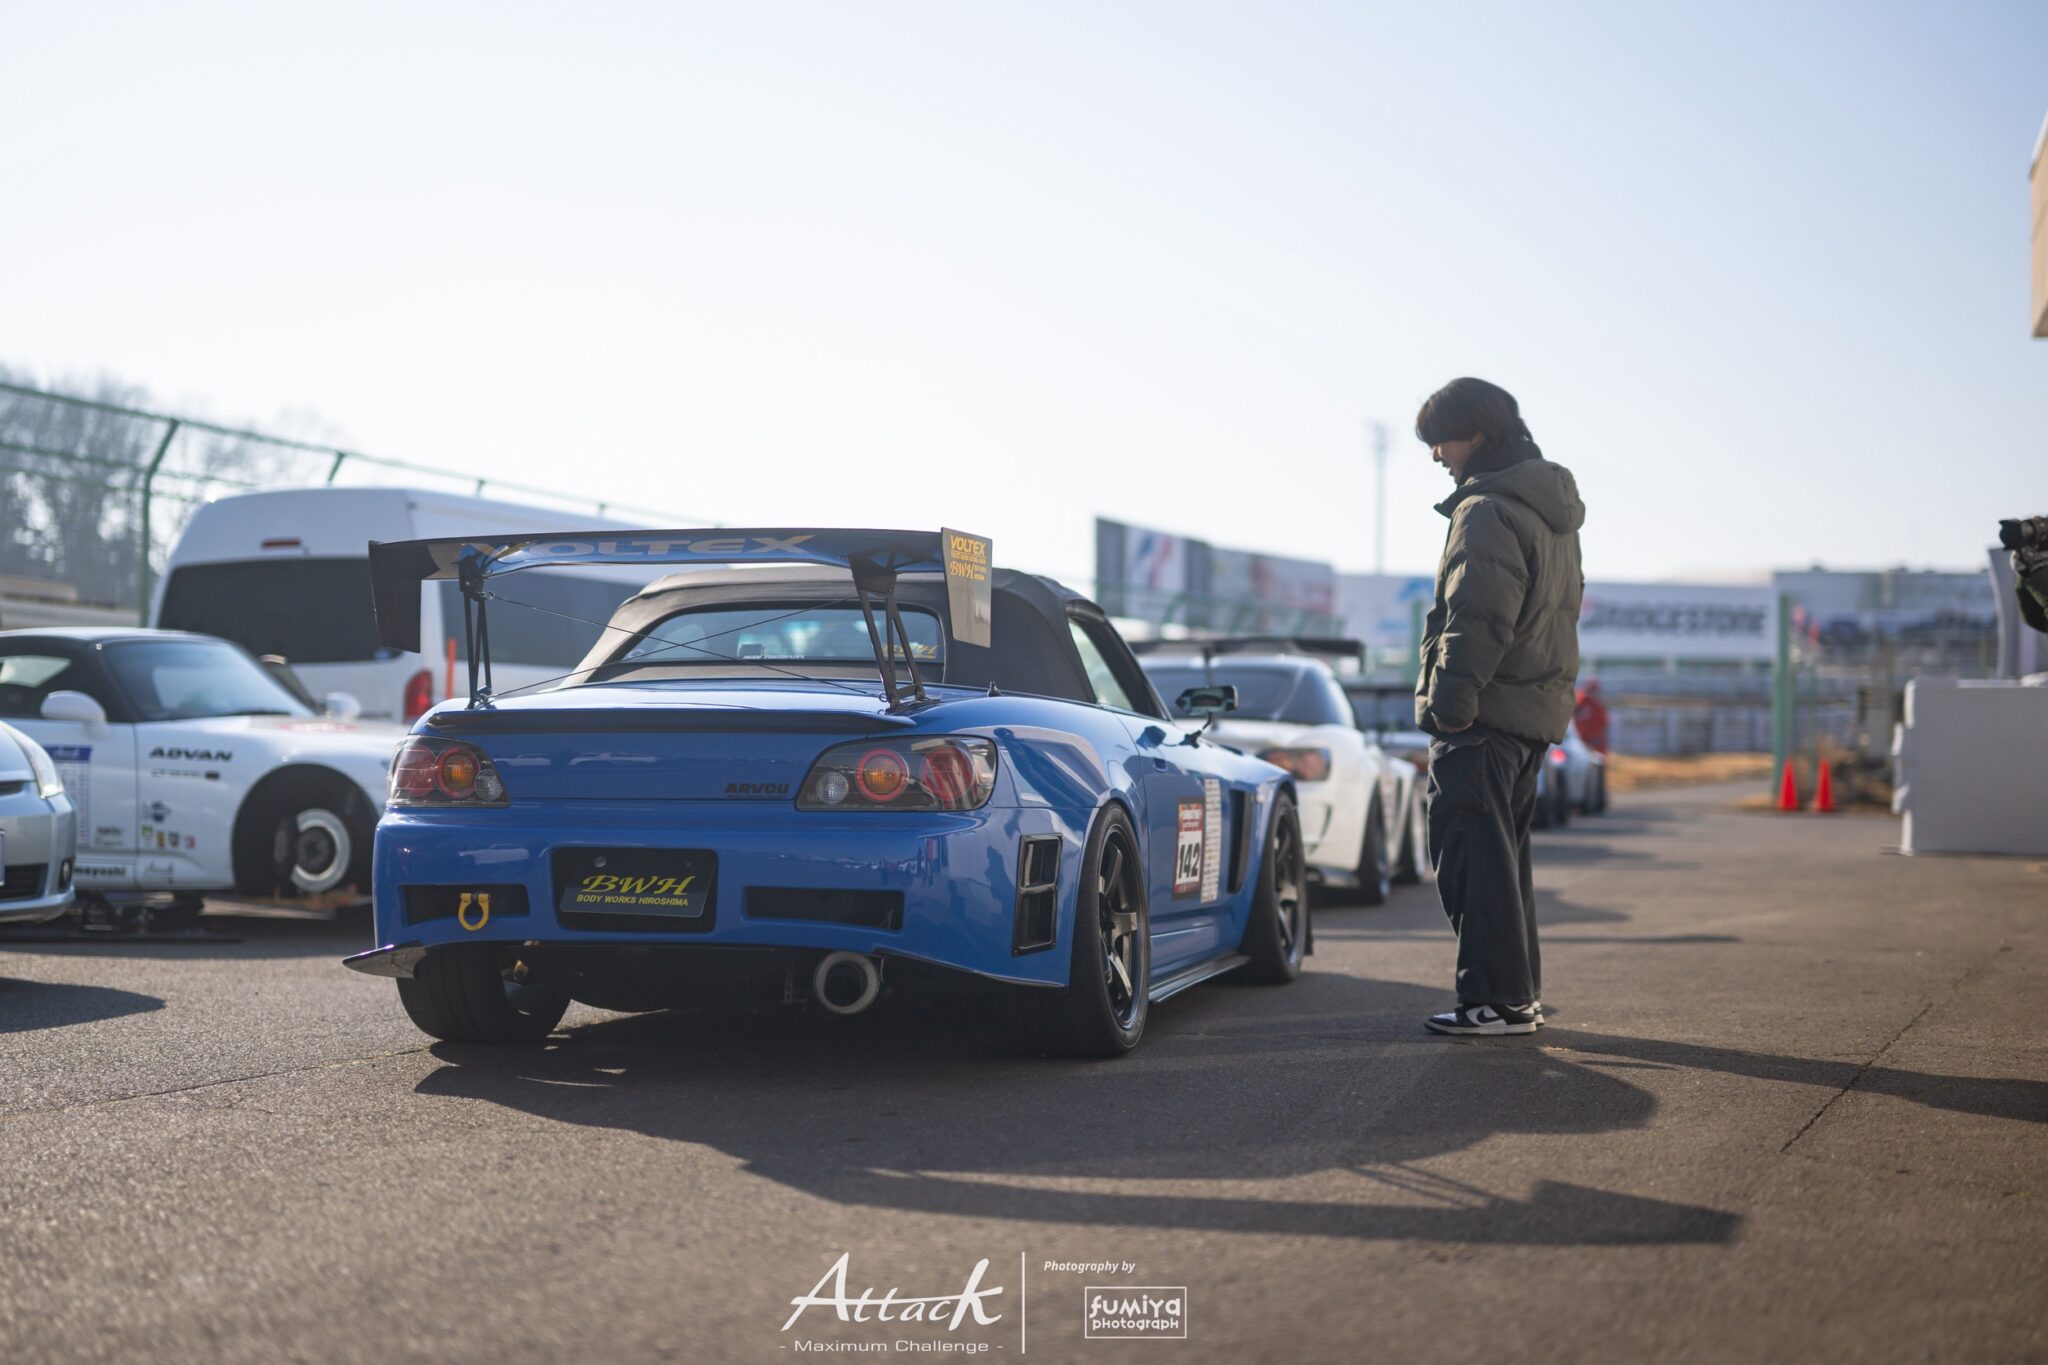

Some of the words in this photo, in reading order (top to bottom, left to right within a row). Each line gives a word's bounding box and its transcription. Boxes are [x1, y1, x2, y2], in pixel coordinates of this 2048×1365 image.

[461, 534, 817, 557] VOLTEX
[950, 535, 986, 557] VOLTEX
[950, 560, 975, 578] BWH
[149, 747, 232, 761] ADVAN
[724, 783, 789, 794] ARVOU
[1178, 842, 1200, 879] 142
[582, 874, 695, 896] BWH
[576, 894, 603, 903] BODY
[604, 895, 636, 904] WORKS
[638, 897, 688, 907] HIROSHIMA
